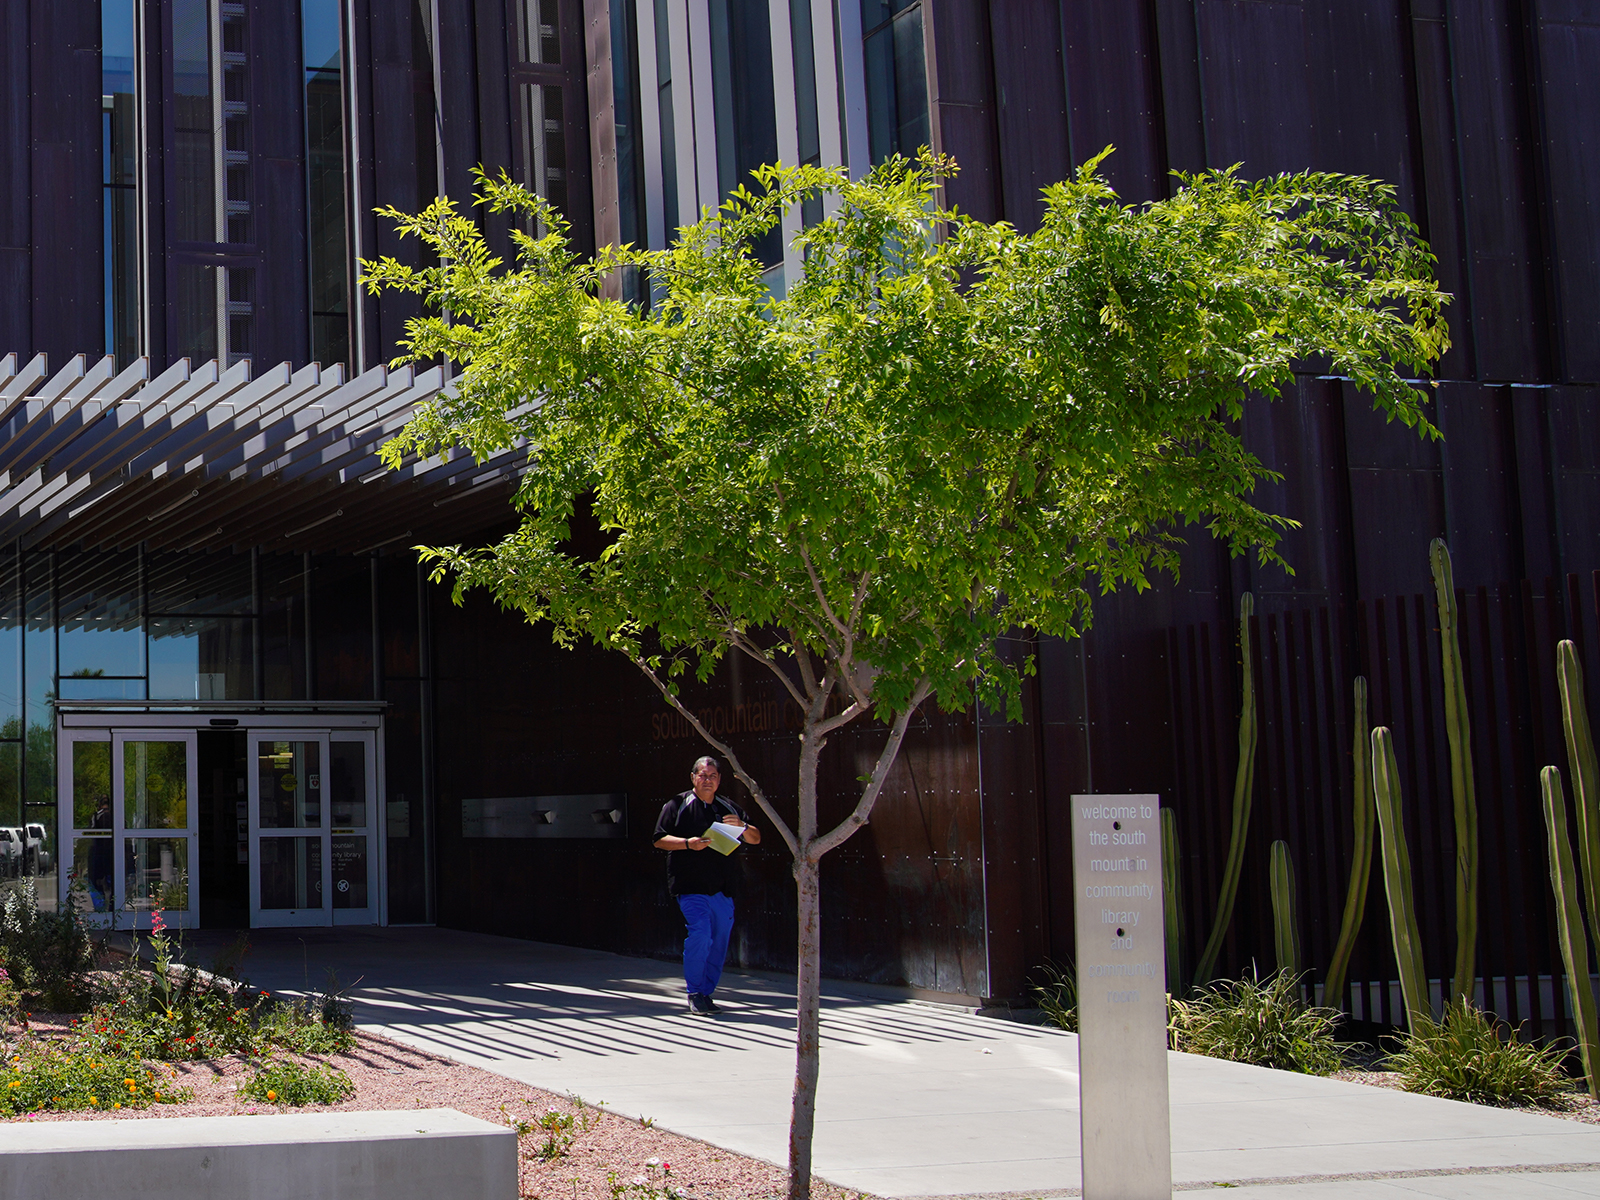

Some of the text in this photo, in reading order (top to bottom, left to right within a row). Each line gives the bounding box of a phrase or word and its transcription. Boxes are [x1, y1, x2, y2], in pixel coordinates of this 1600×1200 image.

[651, 699, 696, 741] south
[697, 691, 779, 735] mountain
[1081, 804, 1152, 819] welcome to
[1089, 829, 1146, 846] the south
[343, 851, 362, 859] library
[1085, 881, 1154, 900] community
[1101, 908, 1140, 926] library
[1110, 934, 1133, 950] and
[1088, 960, 1156, 979] community
[1107, 990, 1140, 1003] room
